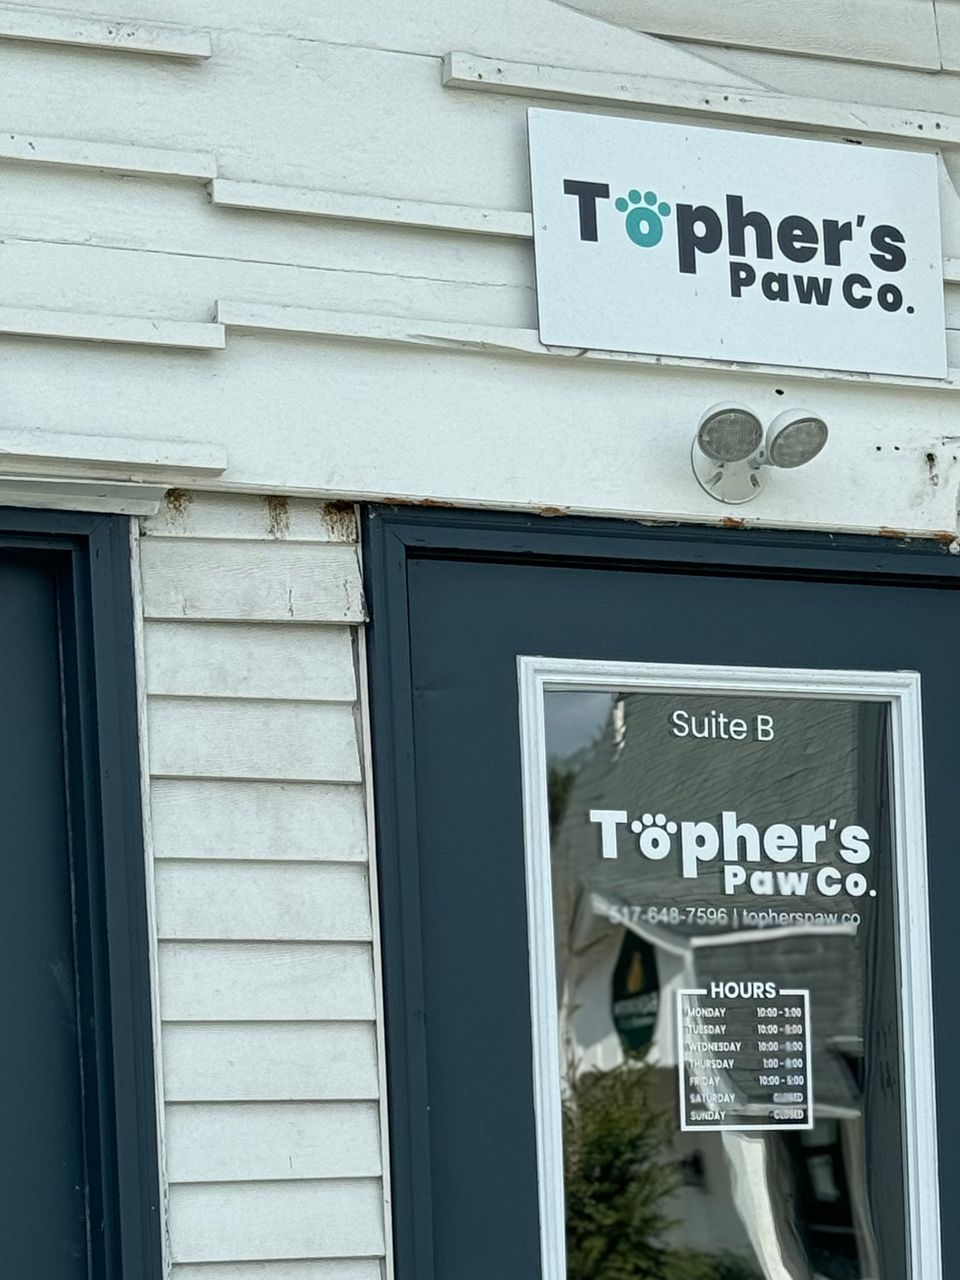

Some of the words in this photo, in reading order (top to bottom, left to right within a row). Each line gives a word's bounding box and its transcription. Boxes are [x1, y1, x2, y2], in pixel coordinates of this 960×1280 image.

[563, 178, 907, 274] Topher's
[729, 261, 832, 306] Paw
[842, 273, 915, 314] Co.
[672, 710, 747, 740] Suite
[757, 715, 775, 741] B
[589, 809, 871, 878] Topher's
[724, 865, 809, 896] Paw
[816, 866, 877, 897] Co.
[711, 982, 776, 999] HOURS
[687, 1007, 726, 1018] MONDAY
[756, 1007, 777, 1018] 10:00
[687, 1024, 726, 1035] TUESDAY
[757, 1024, 778, 1035] 10:00
[688, 1041, 741, 1052] WEDNESDAY
[688, 1058, 734, 1069] THURSDAY
[785, 1058, 803, 1069] :00
[759, 1075, 780, 1086] 10:00
[690, 1092, 735, 1104] SATURDAY
[690, 1110, 726, 1121] SUNDAY
